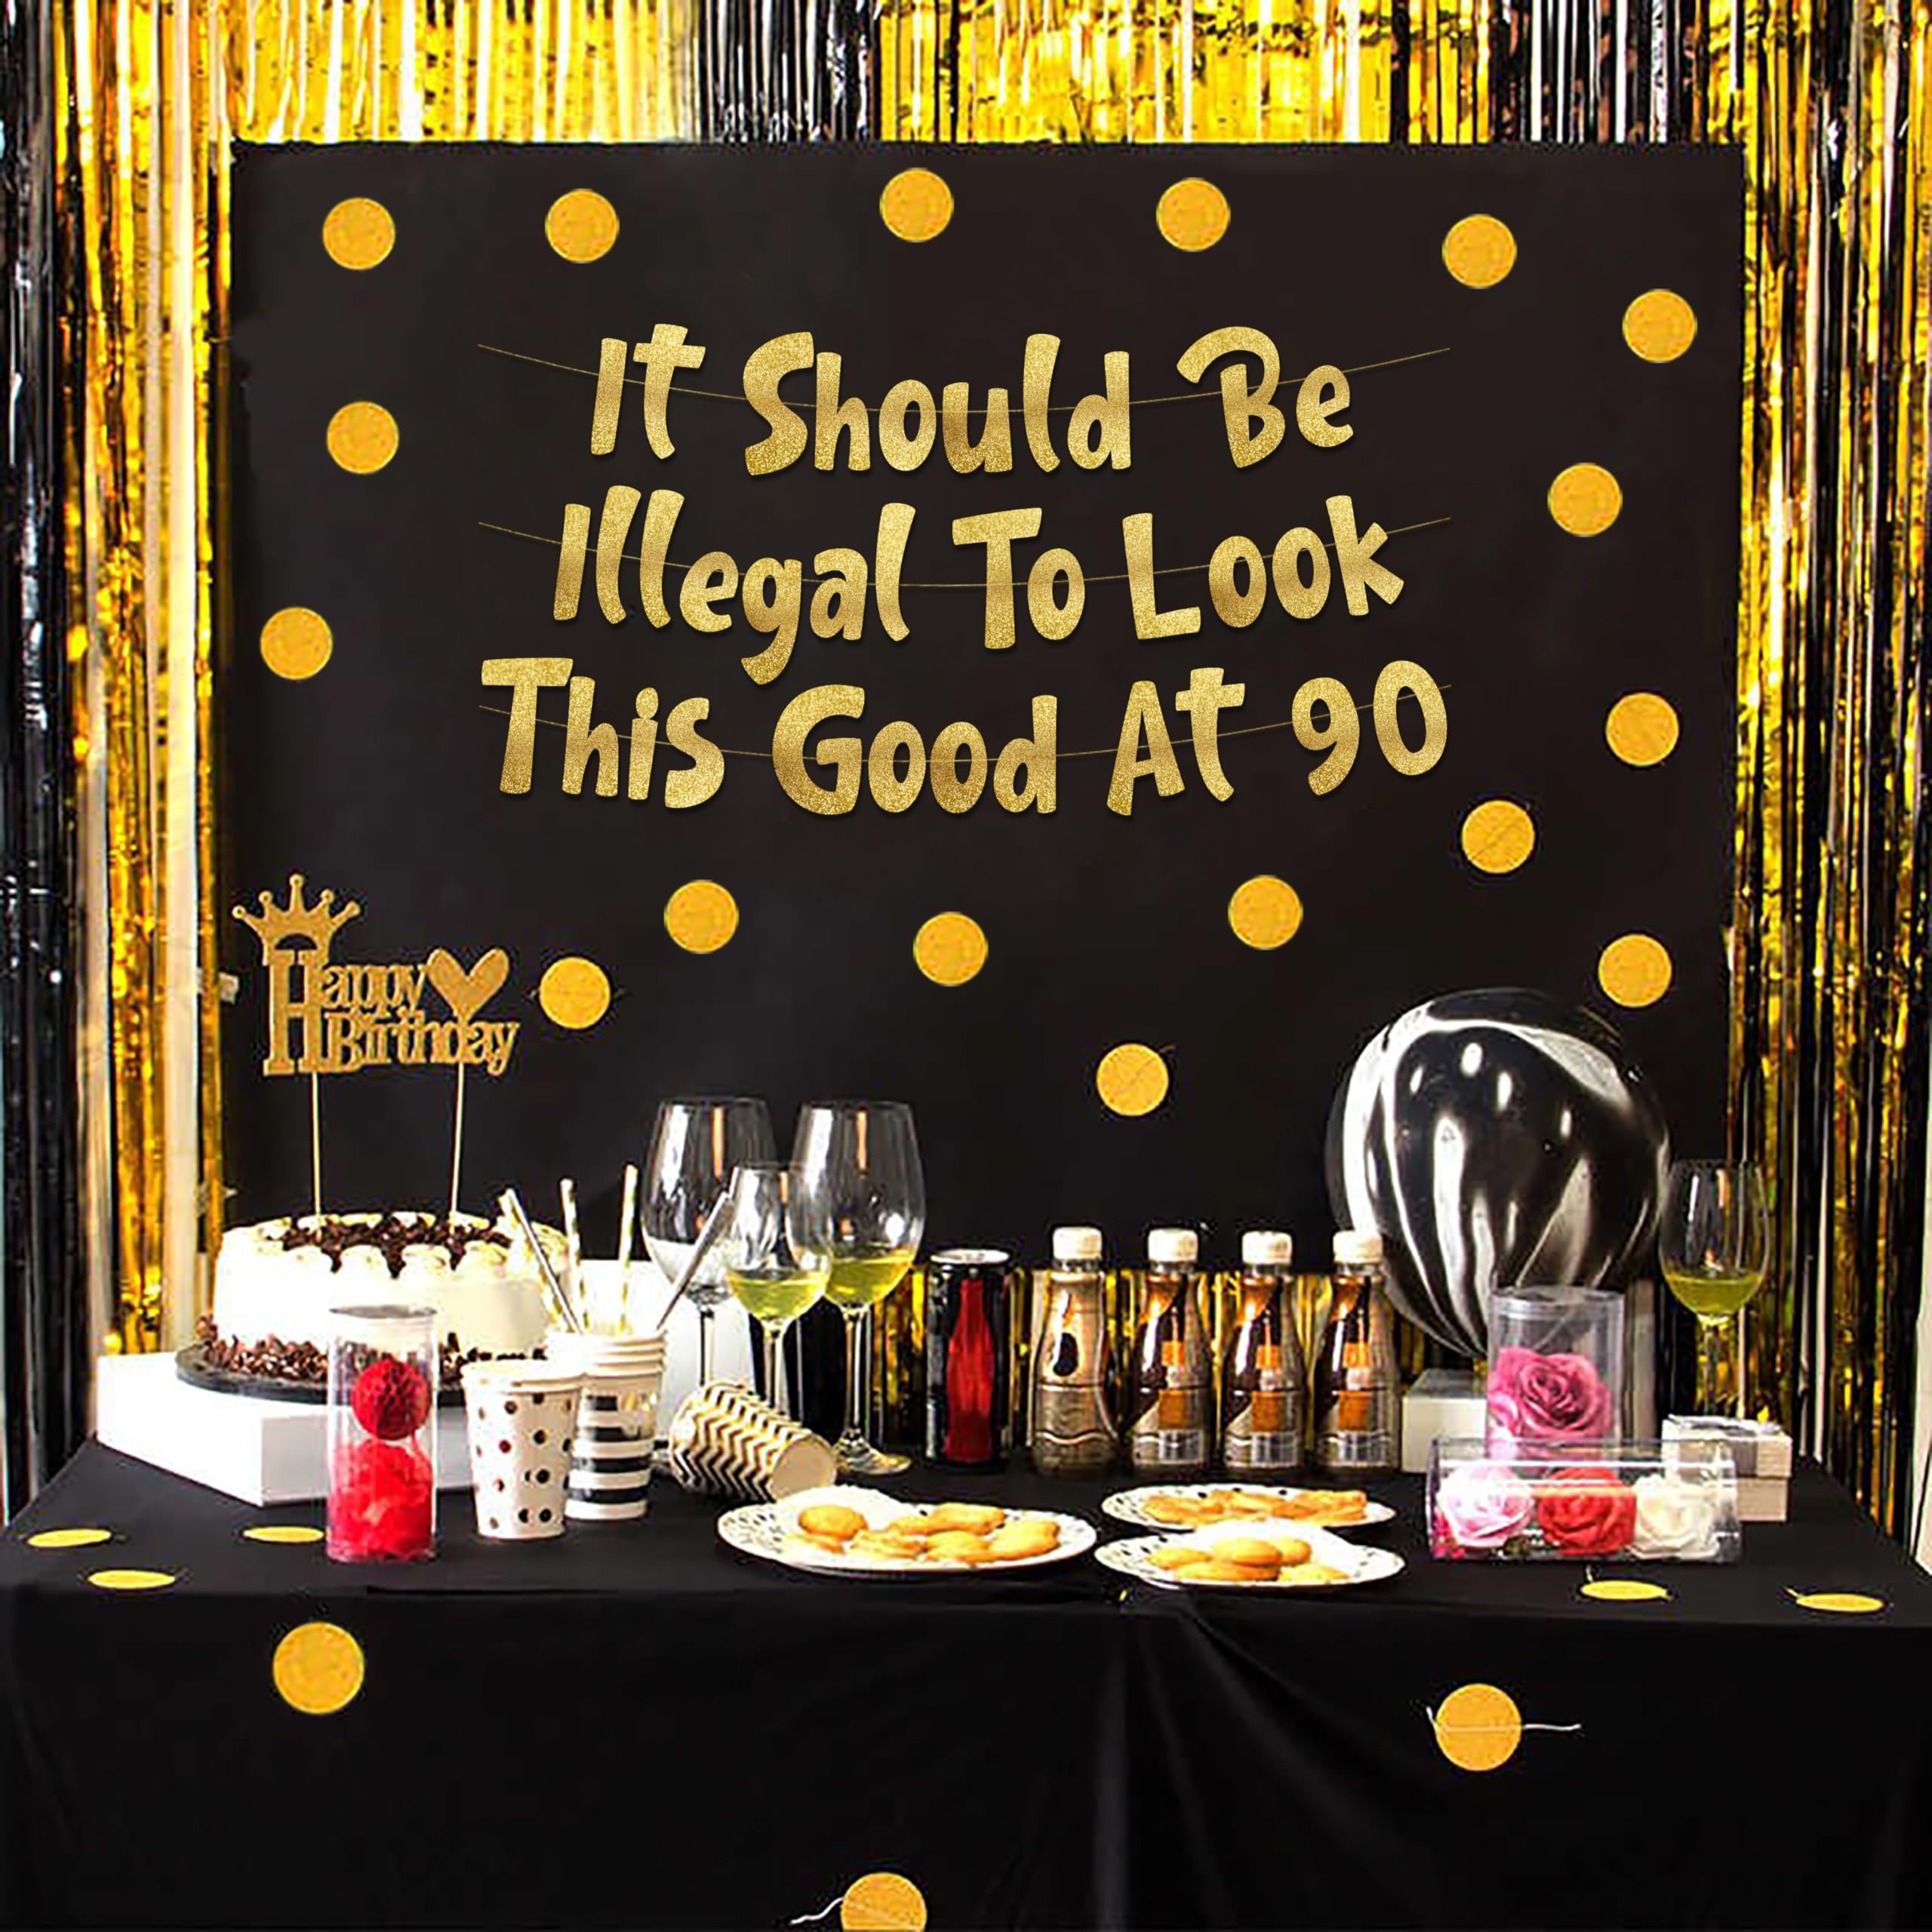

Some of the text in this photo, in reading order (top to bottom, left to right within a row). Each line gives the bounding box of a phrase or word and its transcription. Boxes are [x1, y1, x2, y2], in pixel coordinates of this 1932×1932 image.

[590, 323, 1354, 475] It Should Be
[553, 485, 1404, 685] Illegal To Look
[481, 657, 1447, 816] This Good At 90
[263, 949, 429, 1076] Happy
[324, 1008, 521, 1077] Birthday
